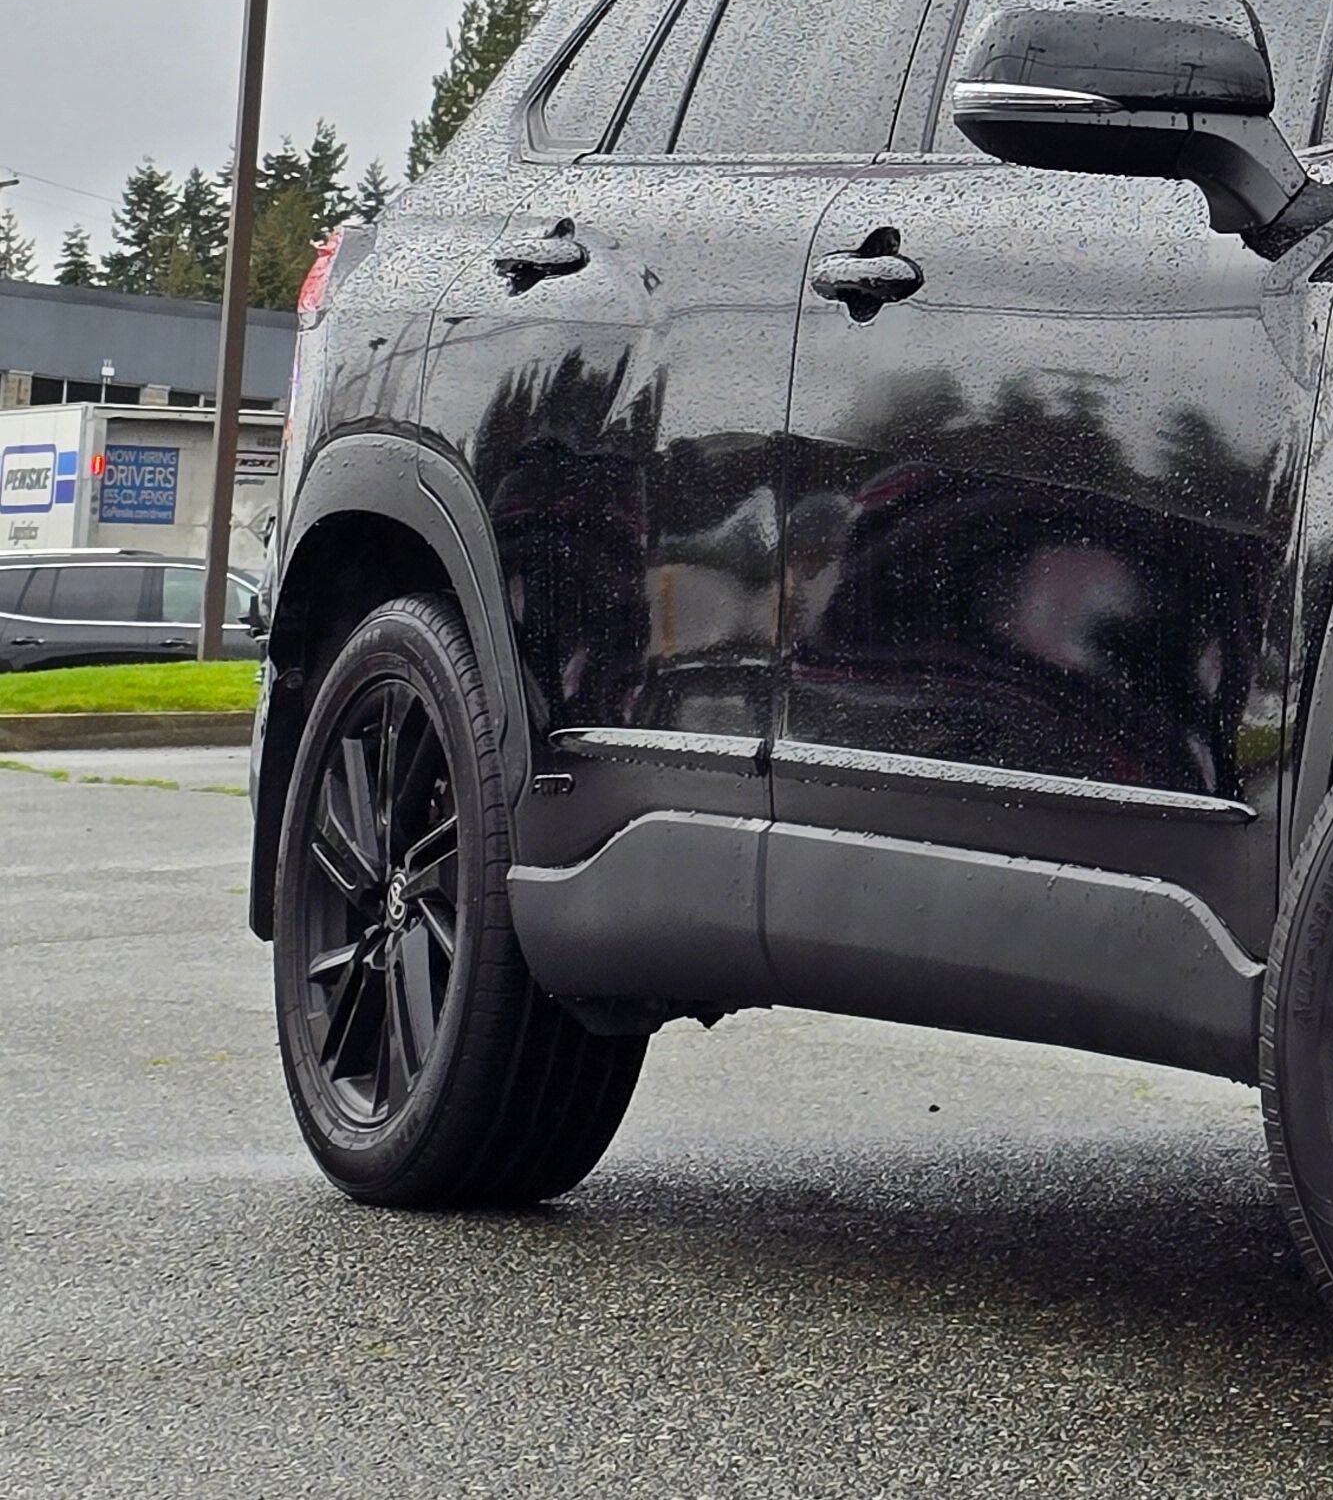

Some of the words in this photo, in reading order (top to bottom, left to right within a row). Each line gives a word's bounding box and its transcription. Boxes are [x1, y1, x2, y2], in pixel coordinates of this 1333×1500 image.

[106, 450, 136, 462] NOW
[139, 452, 177, 465] HIRING
[4, 467, 51, 491] PENSKE
[104, 465, 176, 488] DRIVERS
